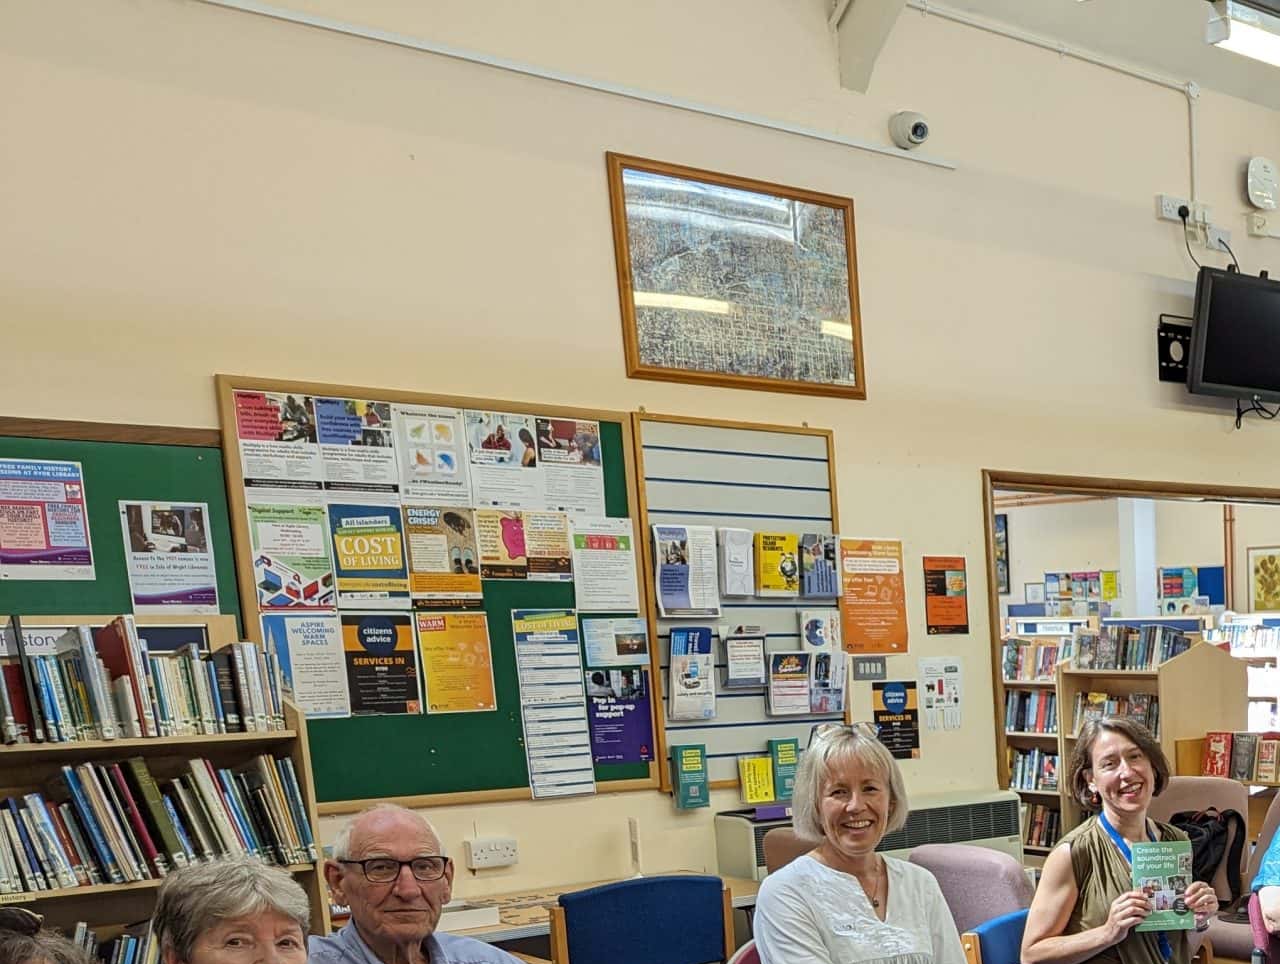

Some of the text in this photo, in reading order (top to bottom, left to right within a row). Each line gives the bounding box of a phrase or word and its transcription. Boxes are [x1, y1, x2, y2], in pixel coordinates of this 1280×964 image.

[407, 508, 441, 517] ENERGY
[408, 517, 438, 525] CRISIS!
[341, 537, 396, 555] COST
[344, 557, 399, 567] OF LIVING
[419, 620, 445, 629] WARM
[363, 627, 393, 636] citizens
[367, 635, 392, 643] advice
[353, 657, 405, 666] SERVICES IN
[592, 697, 607, 705] Pop
[596, 711, 624, 719] support
